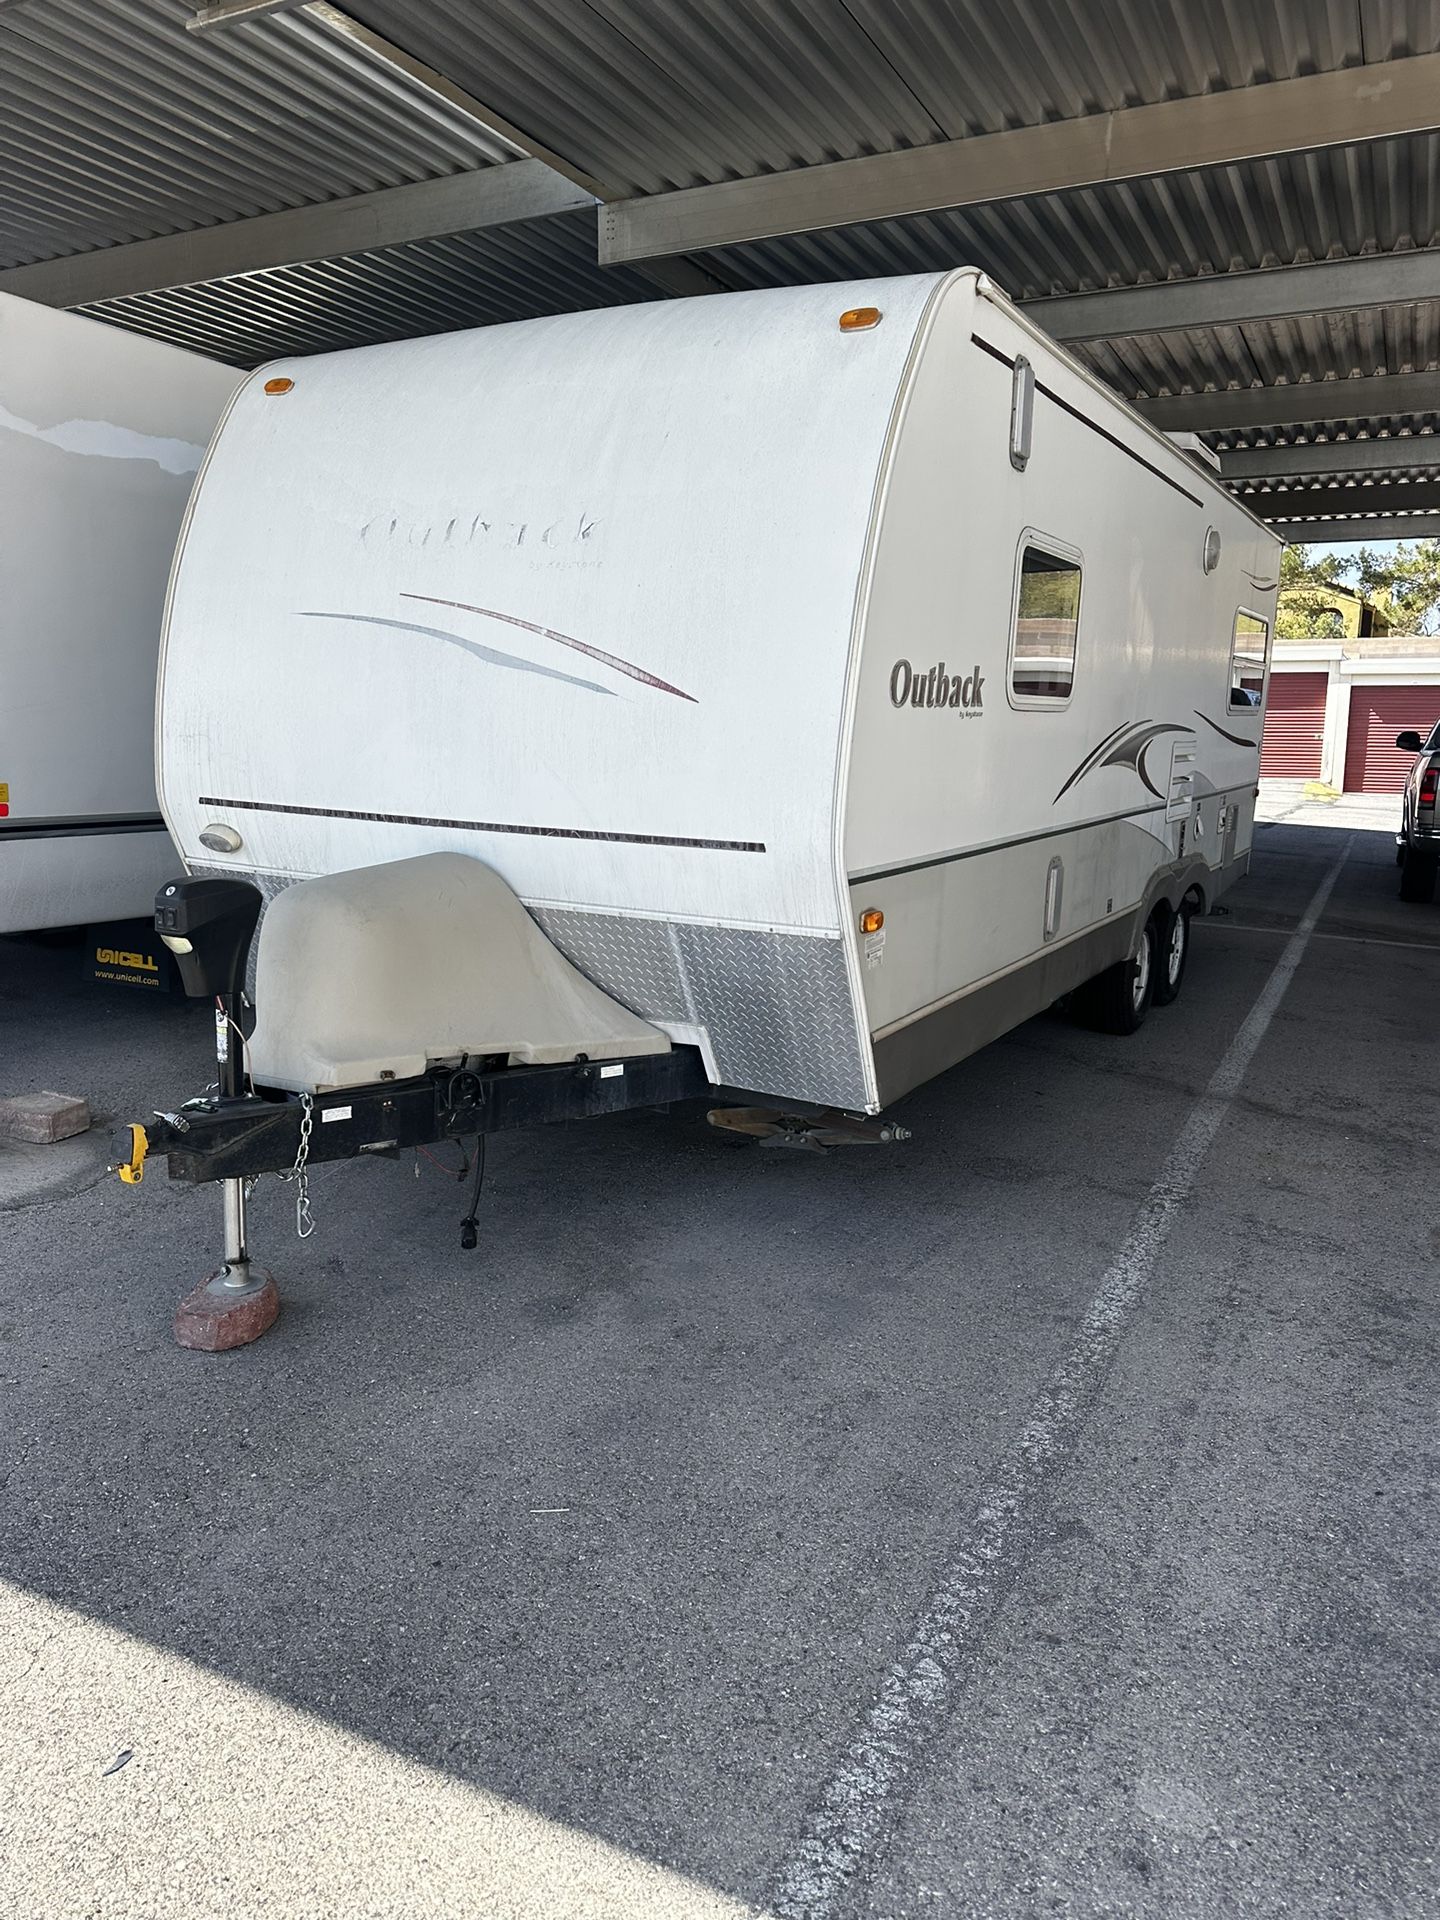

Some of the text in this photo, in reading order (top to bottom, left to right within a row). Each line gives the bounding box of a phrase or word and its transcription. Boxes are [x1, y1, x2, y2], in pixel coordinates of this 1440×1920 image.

[890, 659, 985, 708] Outback
[96, 947, 158, 971] UNICELL
[95, 970, 160, 986] www.unicell.com
